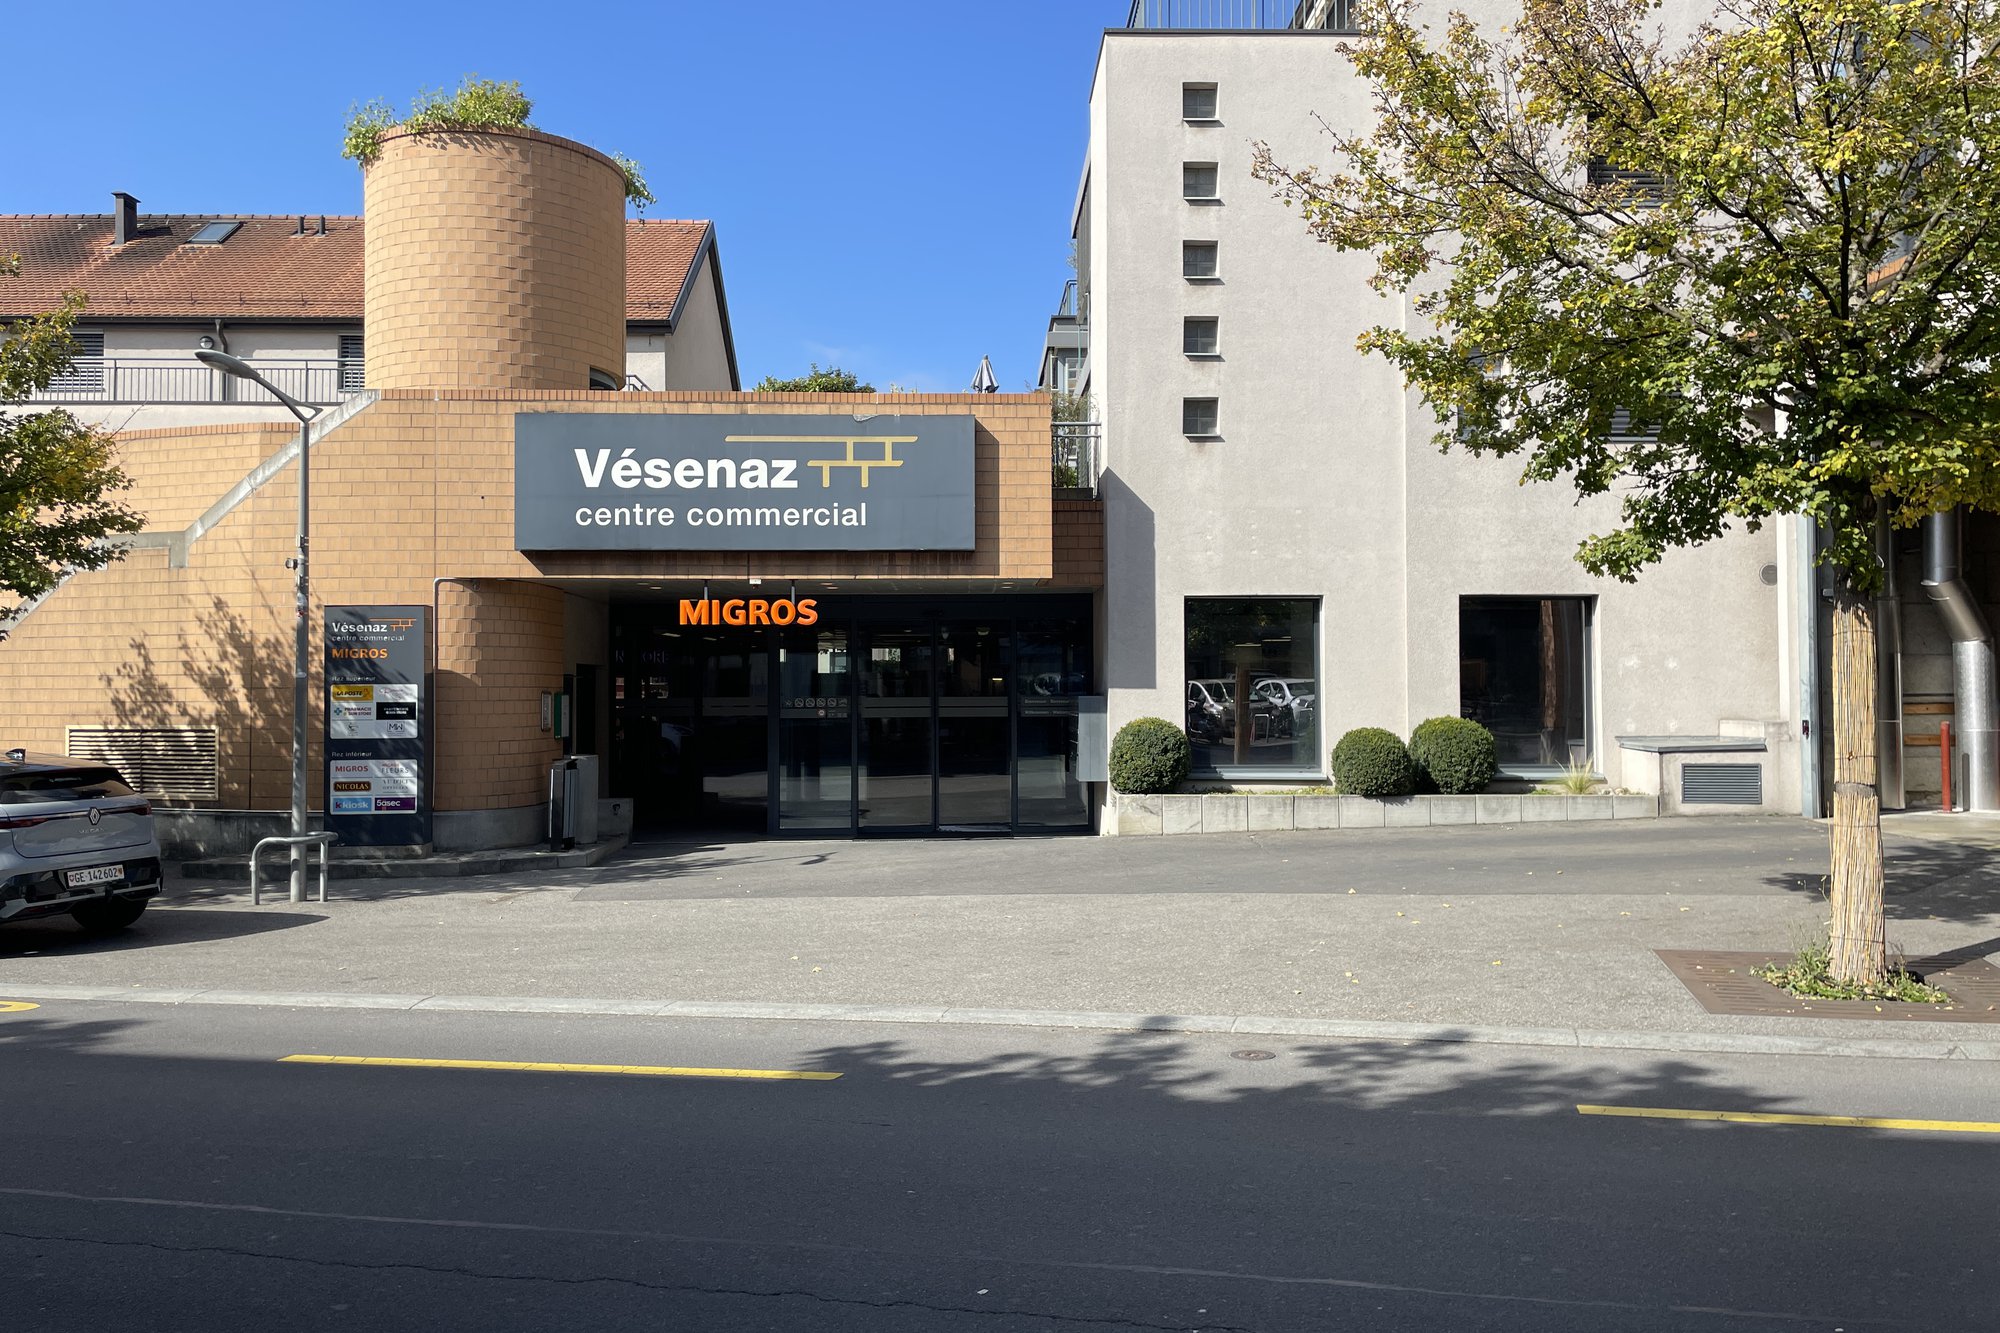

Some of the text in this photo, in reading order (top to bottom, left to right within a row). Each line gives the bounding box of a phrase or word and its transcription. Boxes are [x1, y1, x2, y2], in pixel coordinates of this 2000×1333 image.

[573, 448, 799, 489] Vésenaz
[574, 503, 867, 526] centre commercial
[679, 598, 818, 625] MIGROS
[332, 622, 388, 633] Vésenaz
[332, 648, 388, 659] MIGROS
[376, 799, 401, 807] 5asec
